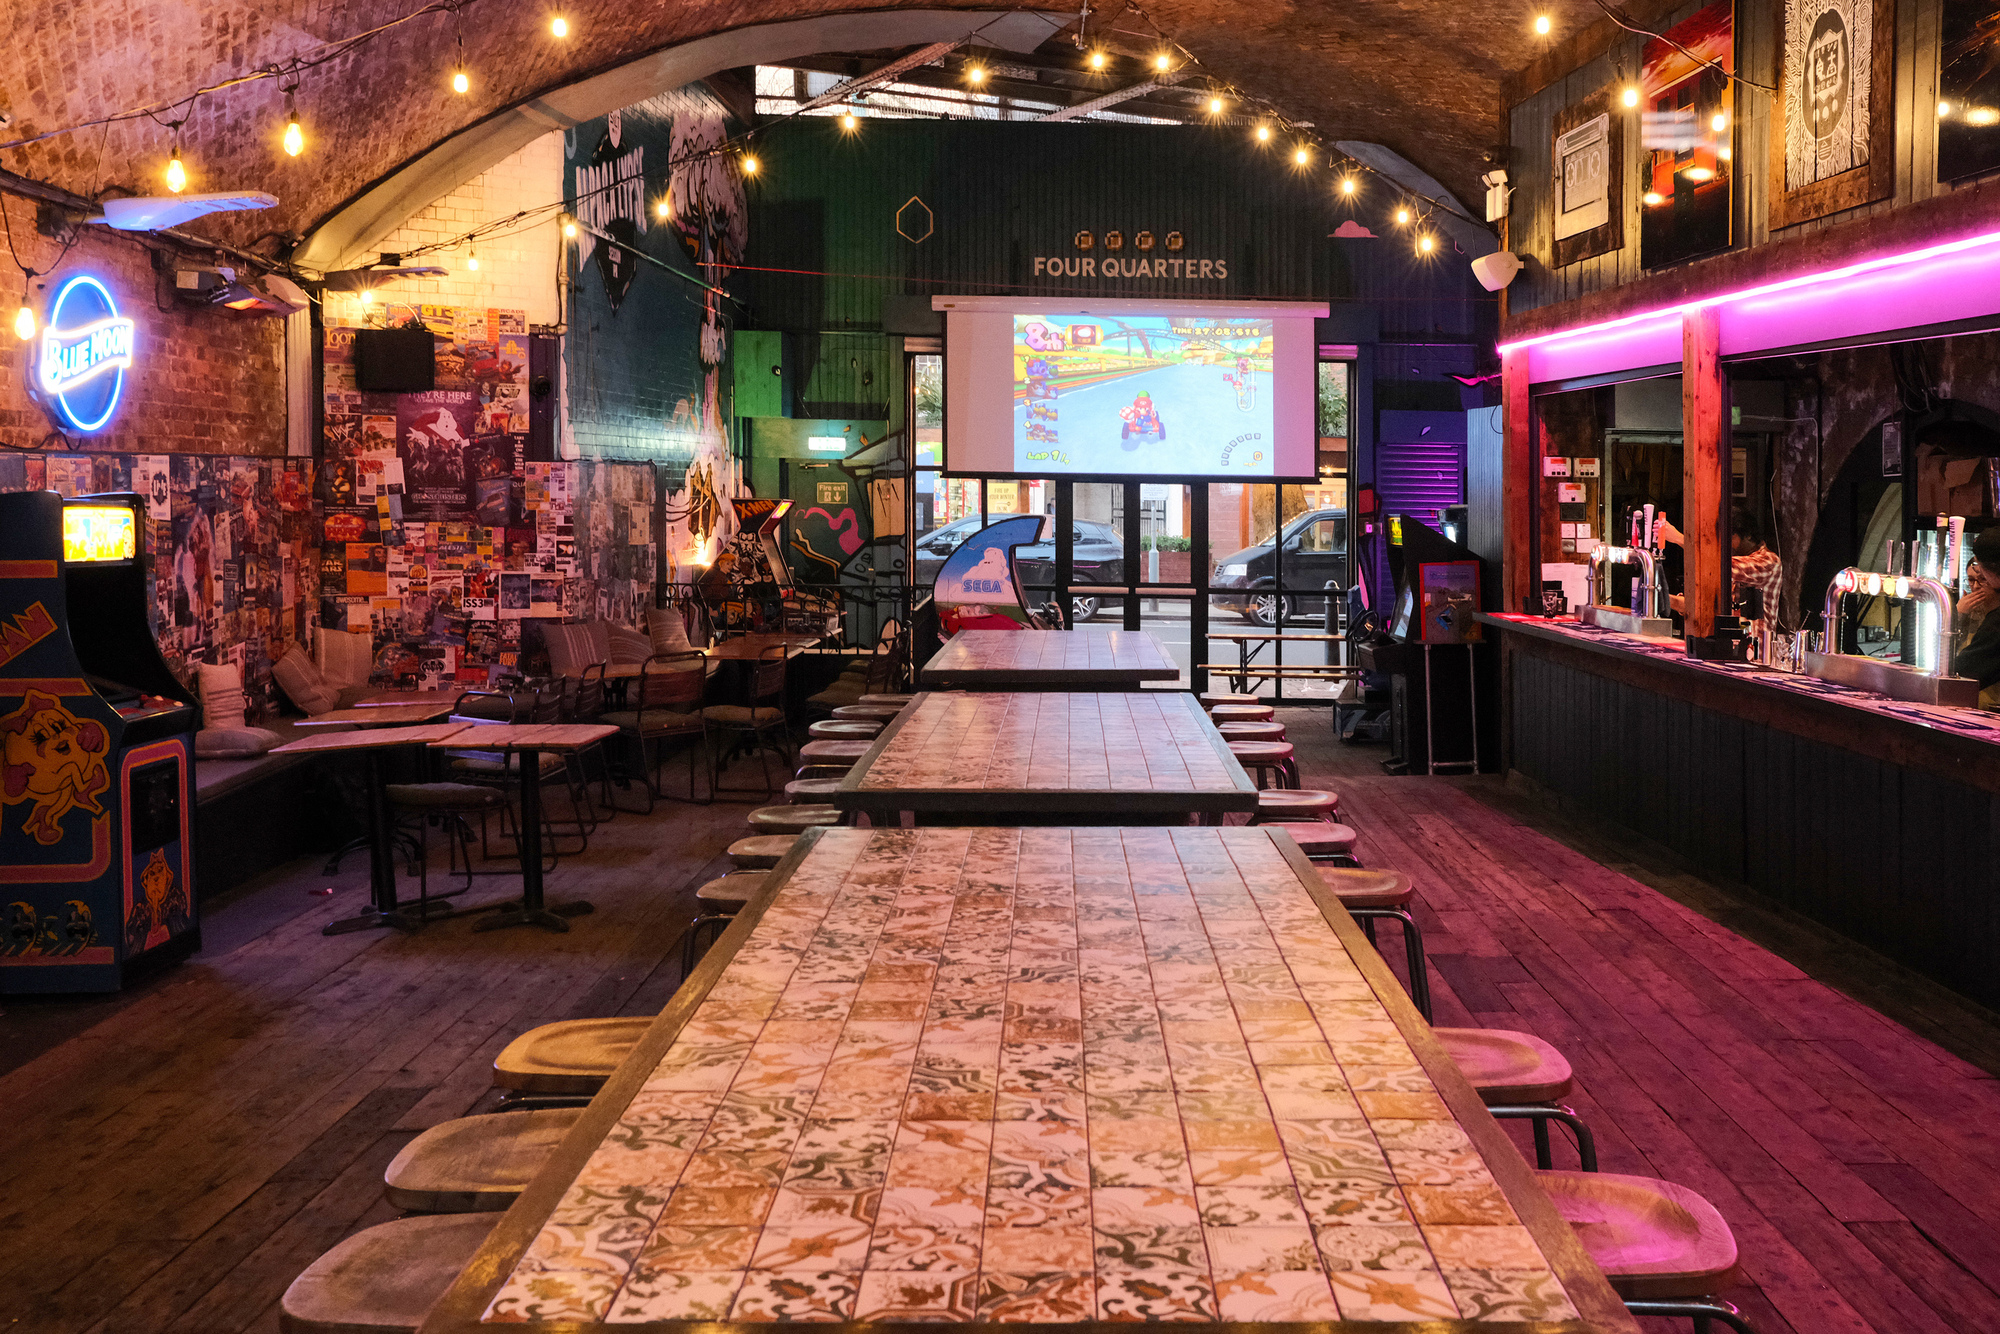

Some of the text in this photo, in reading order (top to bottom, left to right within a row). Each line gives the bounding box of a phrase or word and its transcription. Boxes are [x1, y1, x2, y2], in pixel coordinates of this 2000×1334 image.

[1034, 257, 1228, 279] FOUR QUARTERS
[48, 325, 129, 384] BLUE MOON
[448, 391, 472, 400] HERE
[735, 499, 777, 520] X-MEN
[963, 579, 1002, 593] SEGA
[463, 598, 484, 608] ISS3
